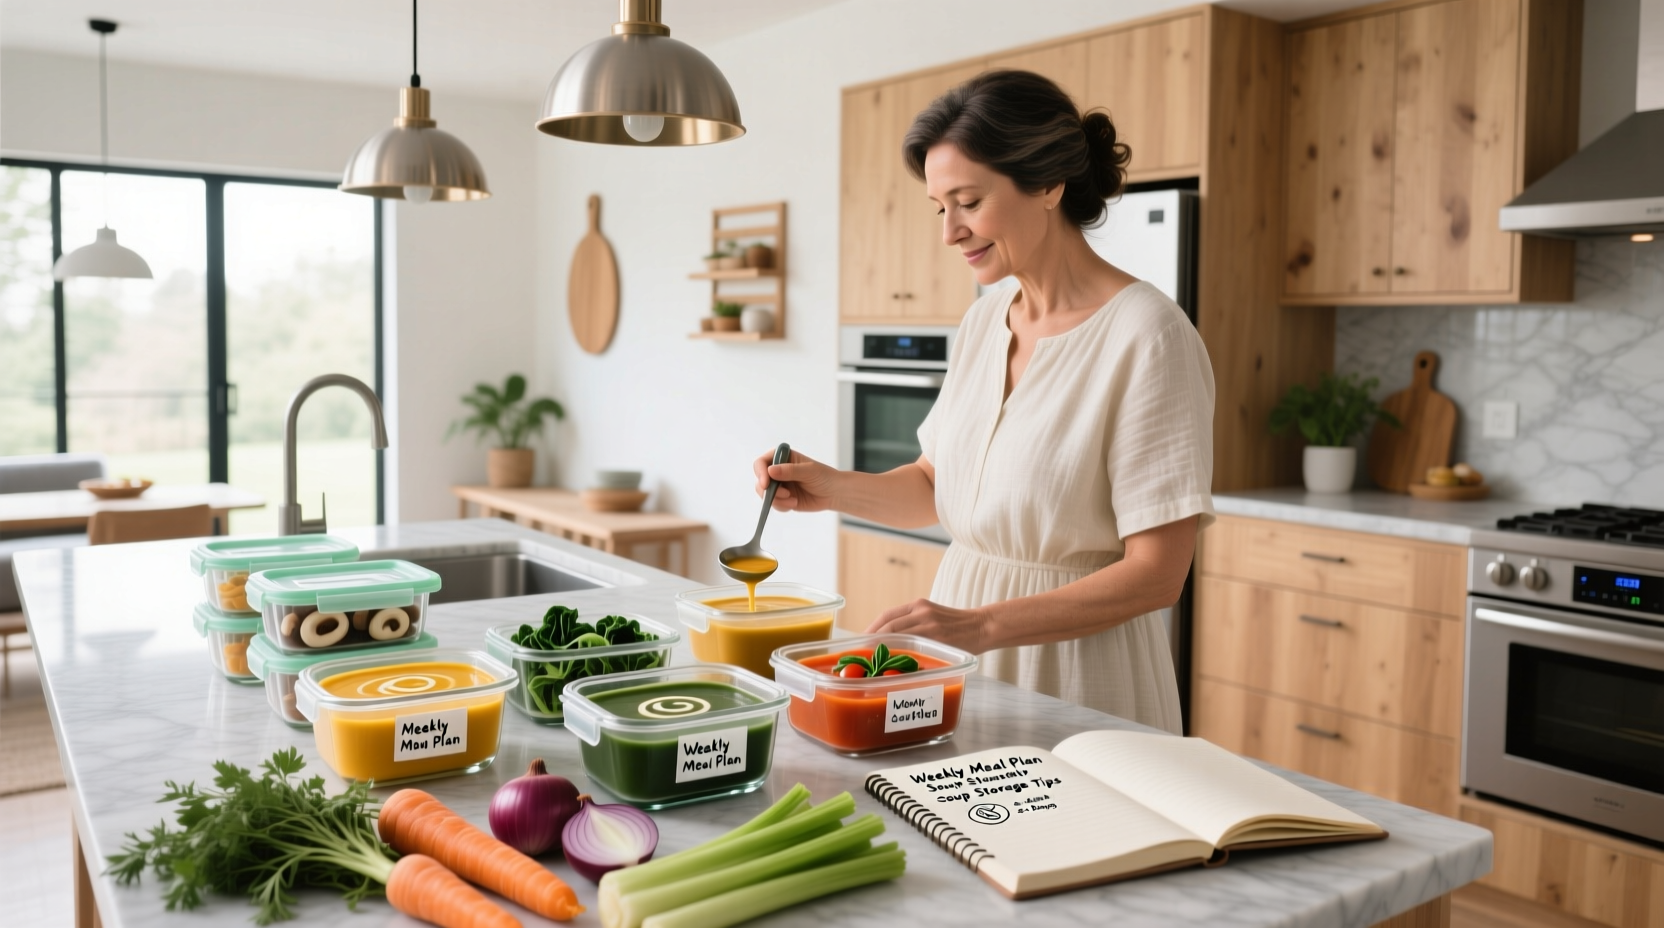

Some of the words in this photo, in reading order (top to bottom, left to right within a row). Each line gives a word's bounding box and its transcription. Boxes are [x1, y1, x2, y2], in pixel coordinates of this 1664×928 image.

[433, 735, 460, 748] Plan
[716, 754, 741, 768] Plan
[1008, 756, 1043, 769] Plan
[1030, 777, 1061, 788] Tips
